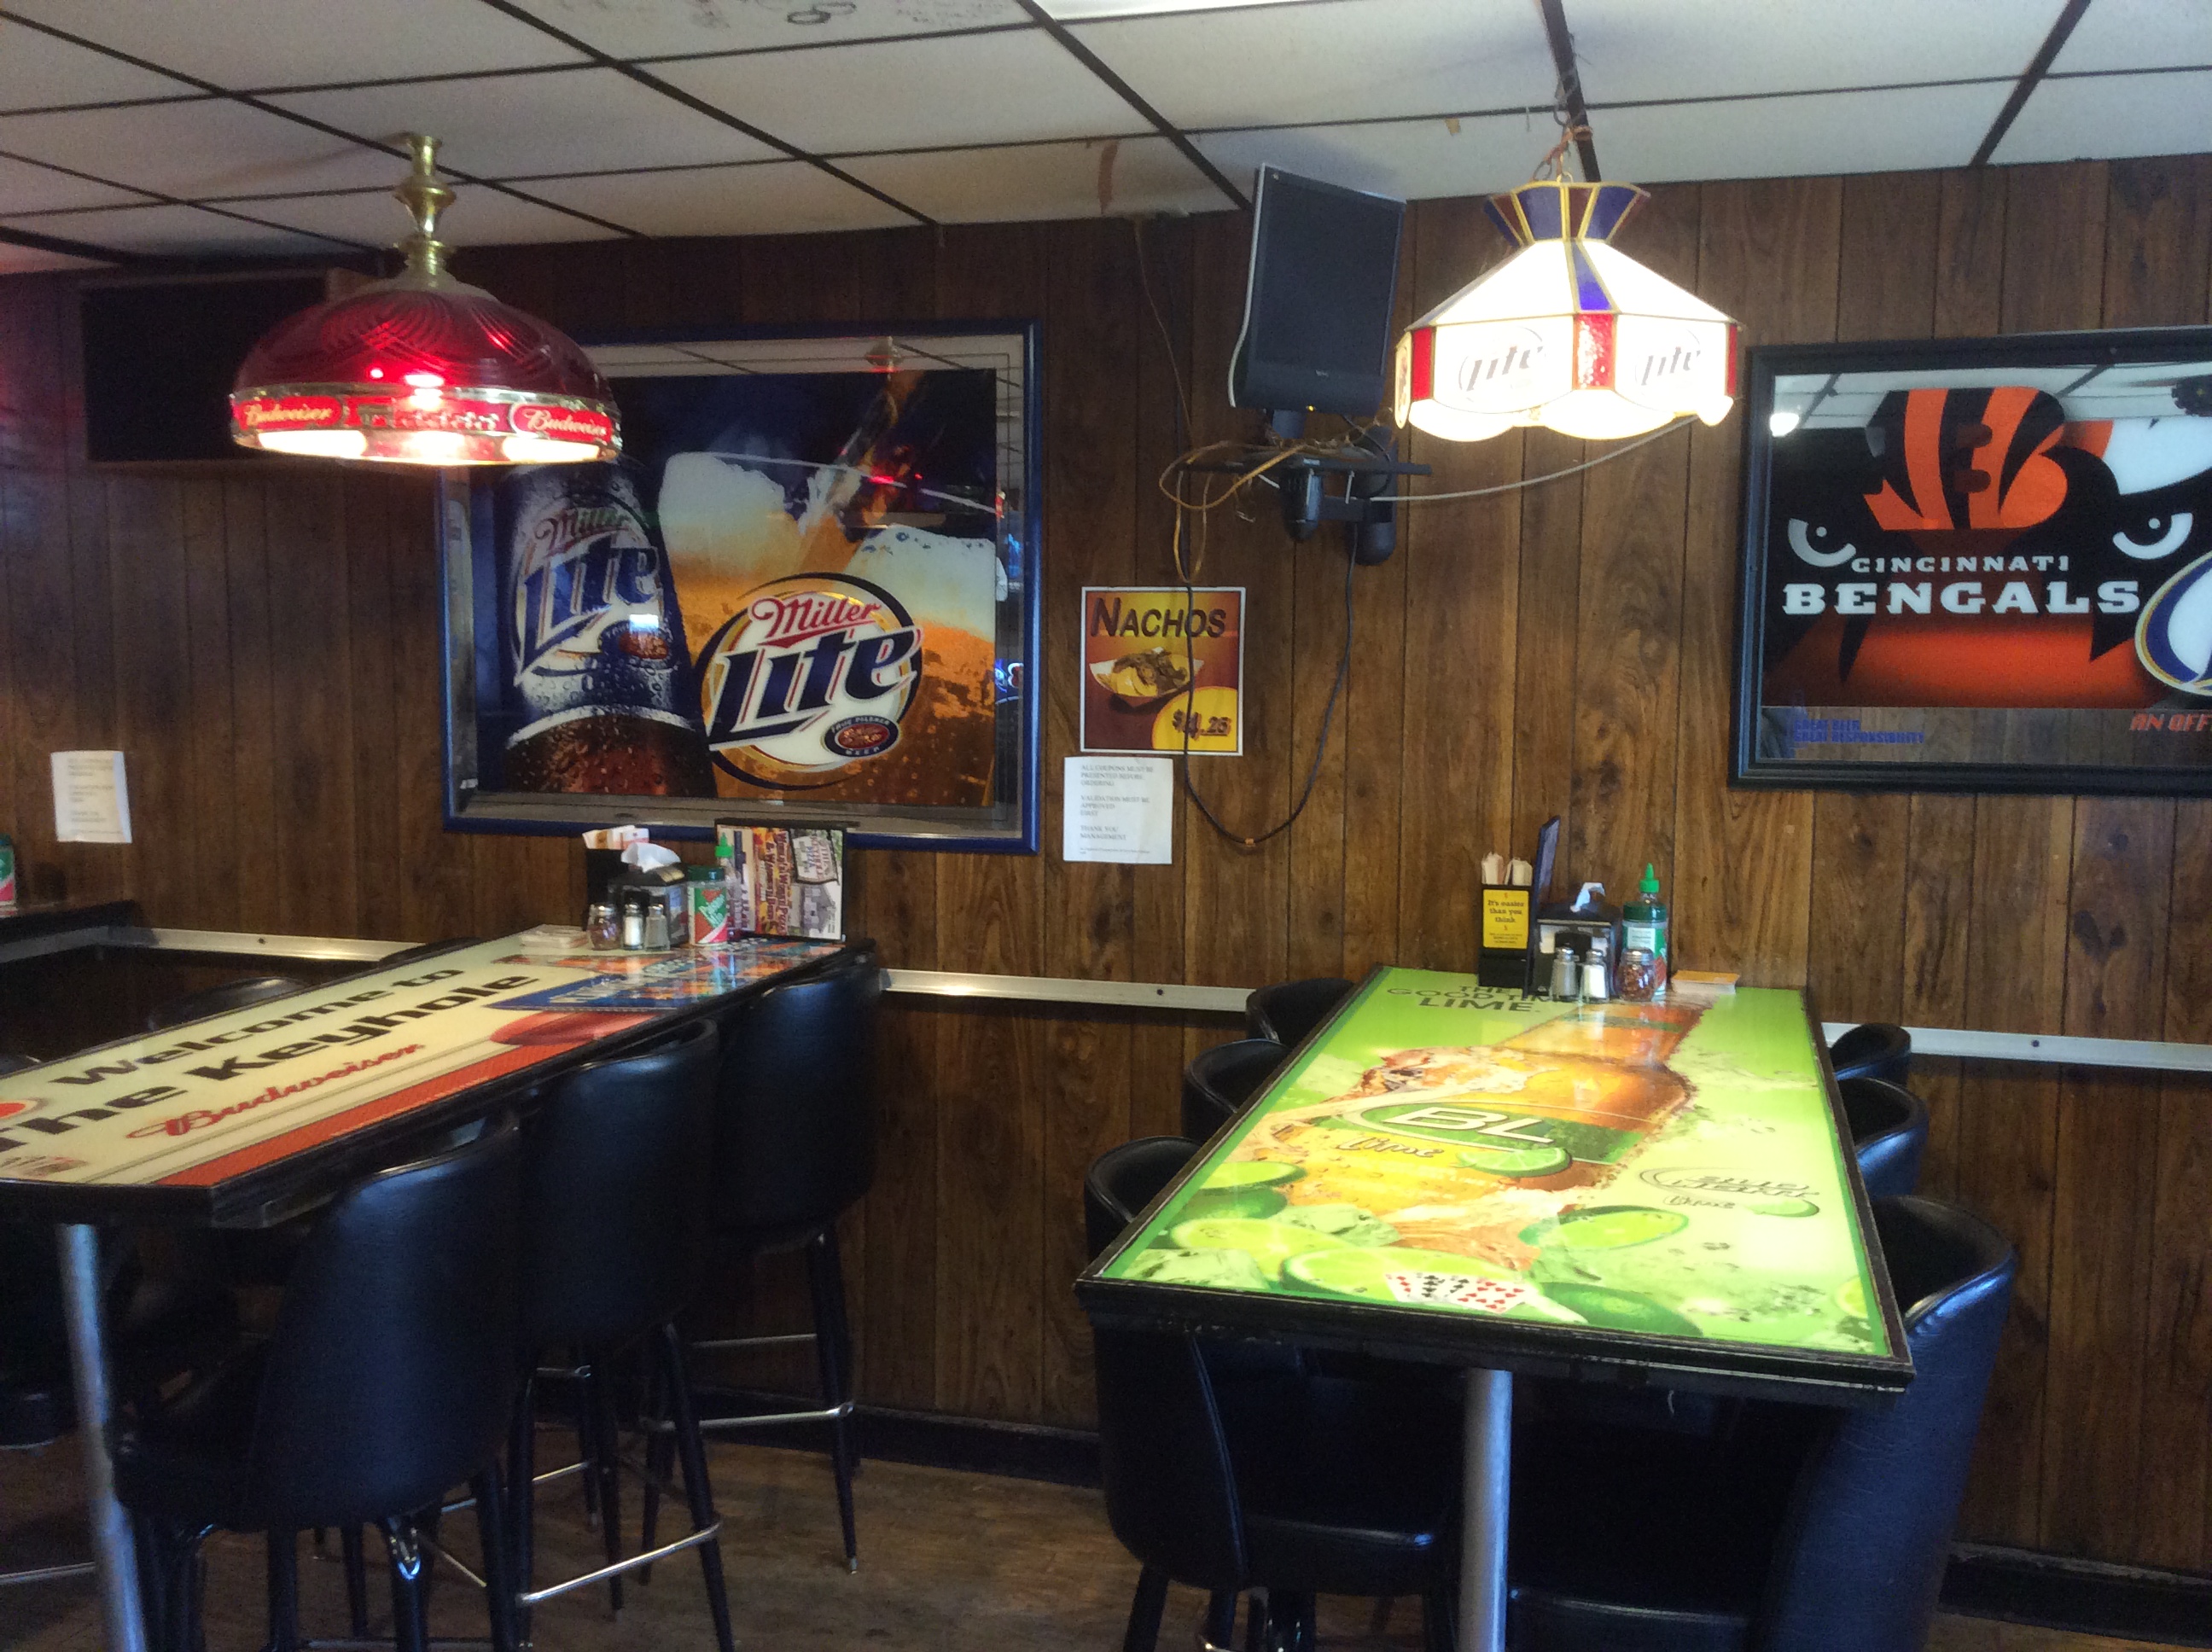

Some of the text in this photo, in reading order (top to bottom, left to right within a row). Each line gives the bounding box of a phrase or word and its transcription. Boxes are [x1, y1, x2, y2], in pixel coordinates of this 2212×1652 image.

[245, 403, 333, 426] Budweiser
[522, 408, 608, 436] Budweiser
[1850, 556, 2069, 573] CINCINNATI
[520, 536, 660, 672] Lite
[1782, 579, 2140, 615] BENGALS
[749, 596, 882, 645] Miller
[1091, 597, 1227, 638] NACHOS
[707, 626, 922, 748] Lite
[1387, 988, 1494, 1000] GOOD
[49, 969, 464, 1085] Welcome to
[183, 974, 540, 1081] Keyhole
[125, 1044, 426, 1141] Budweiser
[1382, 1107, 1555, 1144] BL
[1336, 1137, 1445, 1158] Lime
